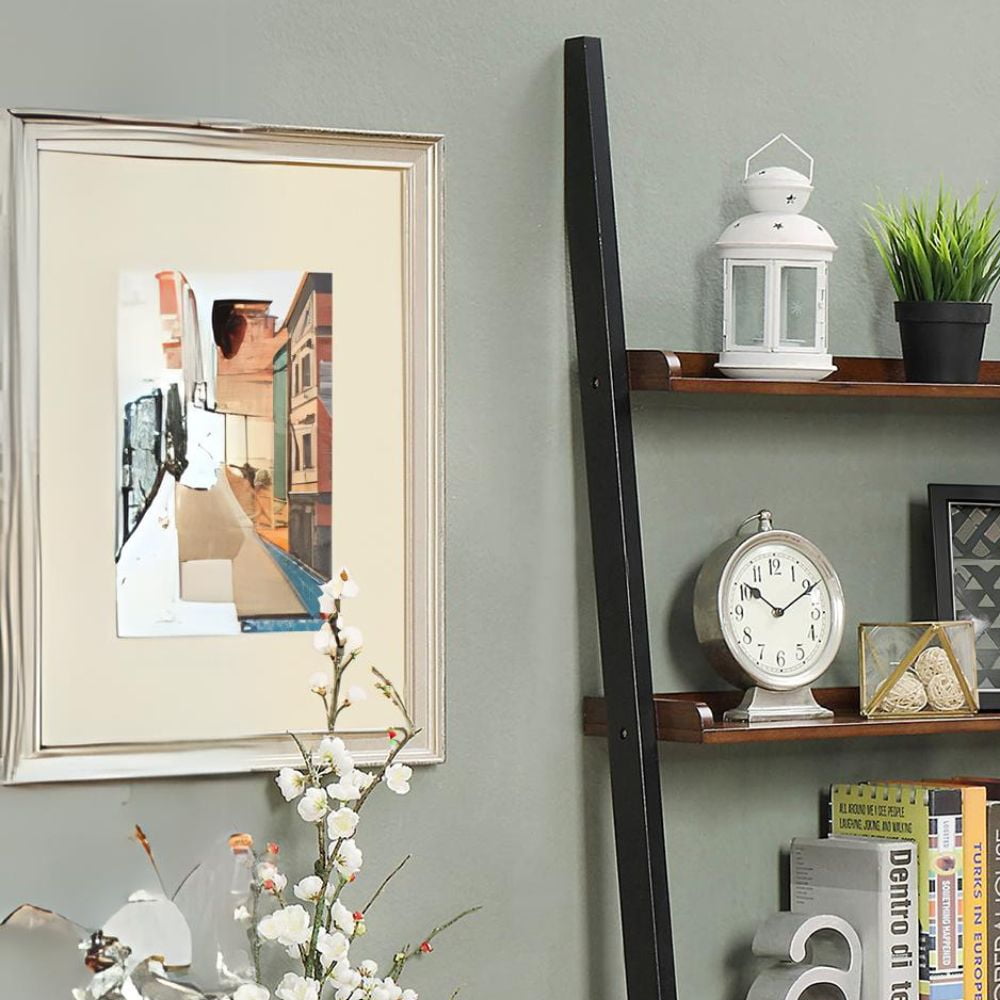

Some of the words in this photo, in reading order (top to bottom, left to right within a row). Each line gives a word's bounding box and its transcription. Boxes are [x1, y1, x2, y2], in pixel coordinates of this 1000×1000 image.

[753, 565, 762, 582] 11
[769, 559, 782, 575] 12
[791, 565, 796, 582] 1
[740, 584, 754, 601] 10
[735, 605, 744, 621] 9
[743, 626, 752, 645] 8
[757, 643, 766, 660] 7
[776, 650, 785, 668] 6
[796, 643, 805, 661] 5
[848, 803, 866, 815] AROUND
[887, 805, 905, 818] PEOPLE
[973, 842, 983, 899] TURKS
[889, 849, 912, 935] Dentro
[974, 906, 982, 925] IN
[890, 944, 912, 968] di
[974, 933, 983, 1000] EUROPE
